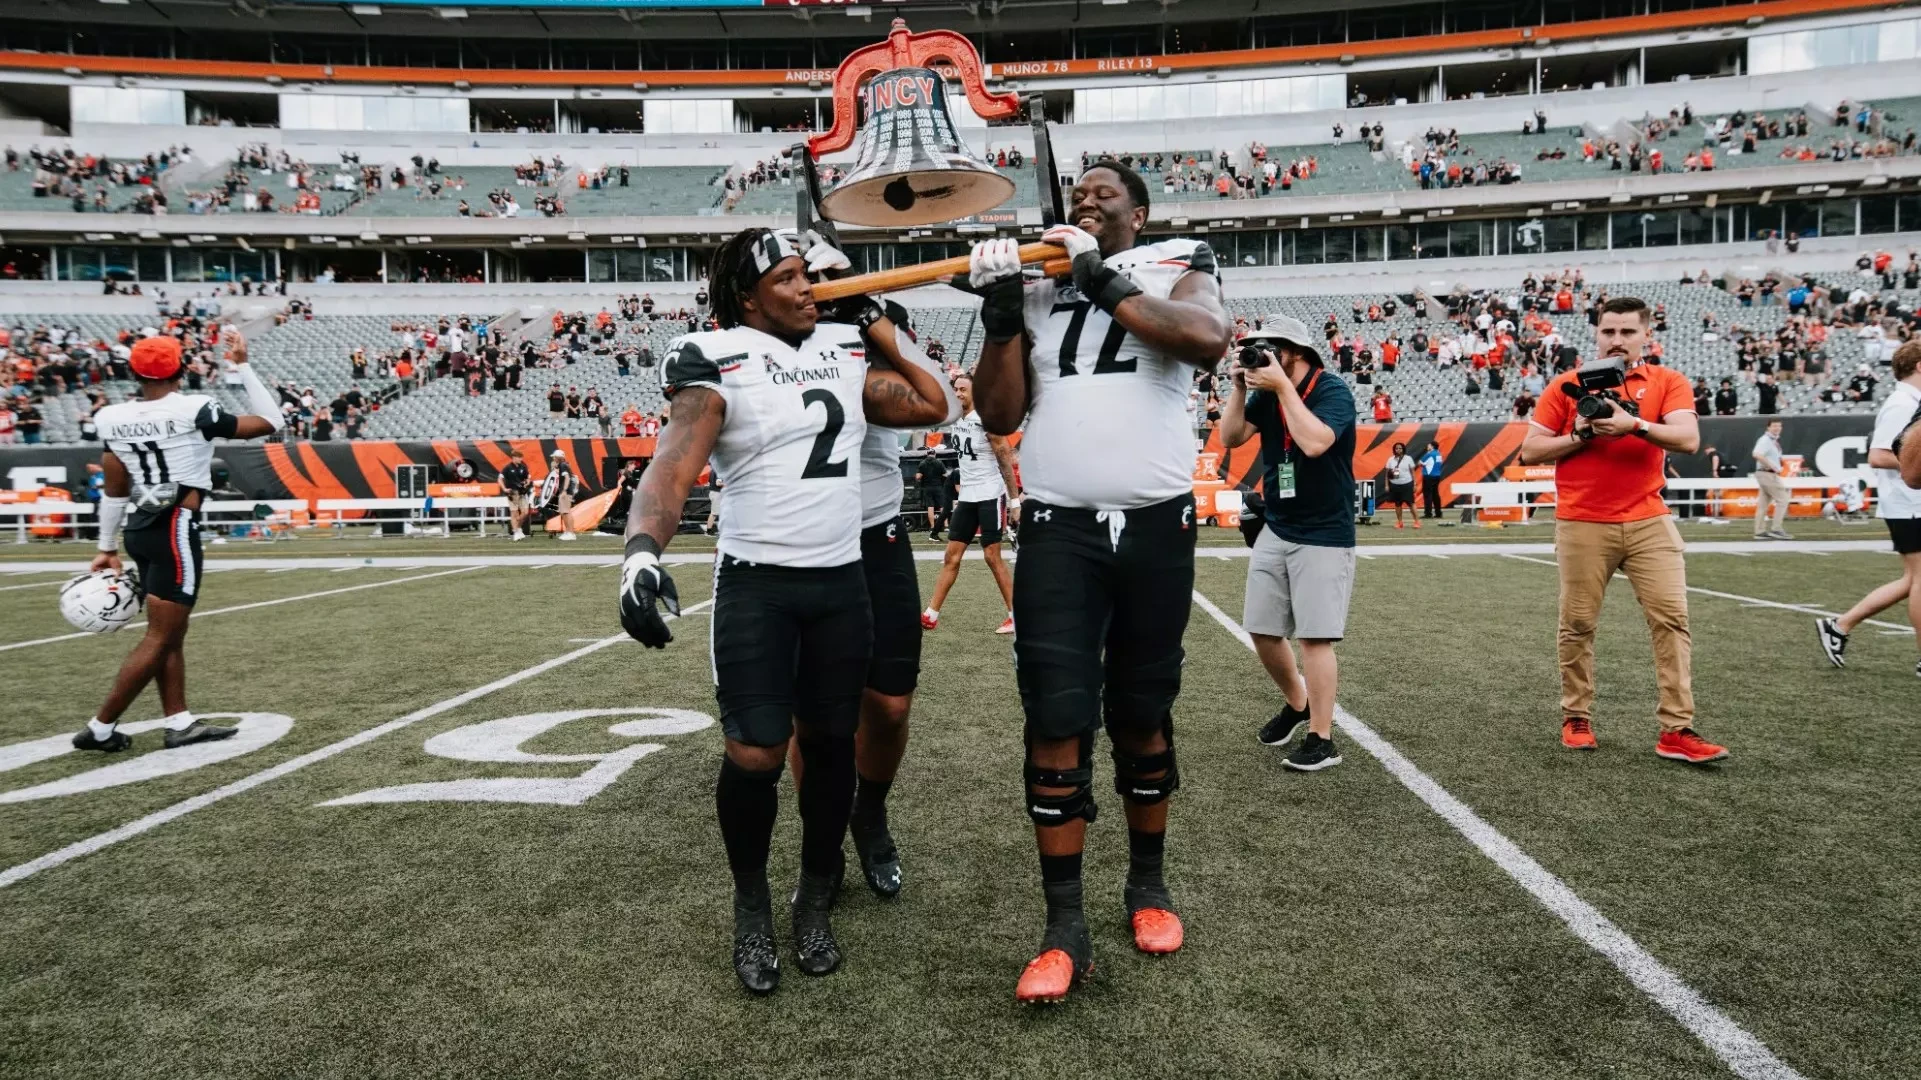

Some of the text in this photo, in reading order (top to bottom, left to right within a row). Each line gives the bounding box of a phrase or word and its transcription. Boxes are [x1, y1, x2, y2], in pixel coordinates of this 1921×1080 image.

[1053, 62, 1068, 73] 78
[1098, 57, 1152, 71] RILEY 13
[785, 70, 838, 81] ANDERS
[896, 109, 912, 120] 1989
[896, 119, 912, 129] 1993
[980, 214, 1015, 223] STADIUM
[772, 366, 841, 386] CINCINNATI
[111, 420, 177, 439] ANDERSON JR
[801, 388, 849, 480] 2
[127, 440, 170, 485] 11
